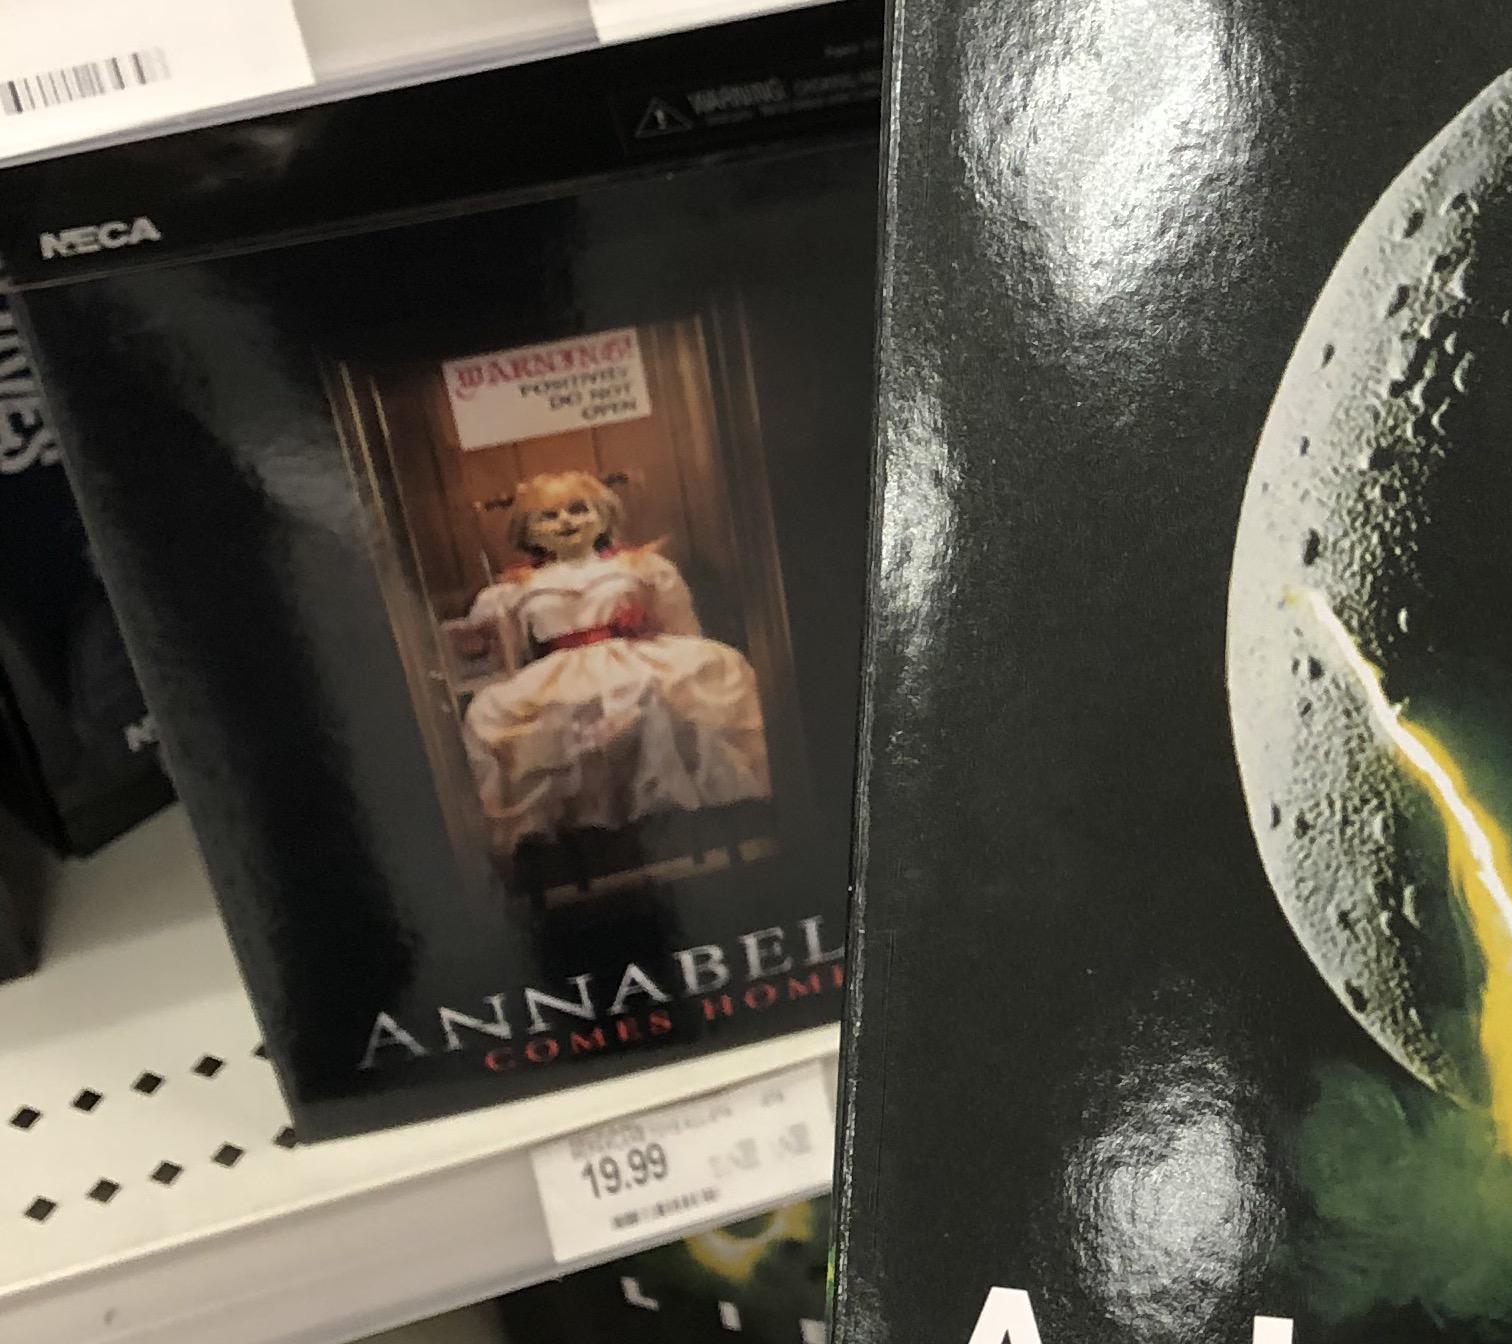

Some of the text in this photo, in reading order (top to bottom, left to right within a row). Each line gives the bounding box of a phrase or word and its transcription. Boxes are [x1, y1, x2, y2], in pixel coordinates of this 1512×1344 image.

[39, 216, 161, 260] NECA
[485, 1009, 673, 1072] COMES
[581, 1142, 669, 1199] 19.99
